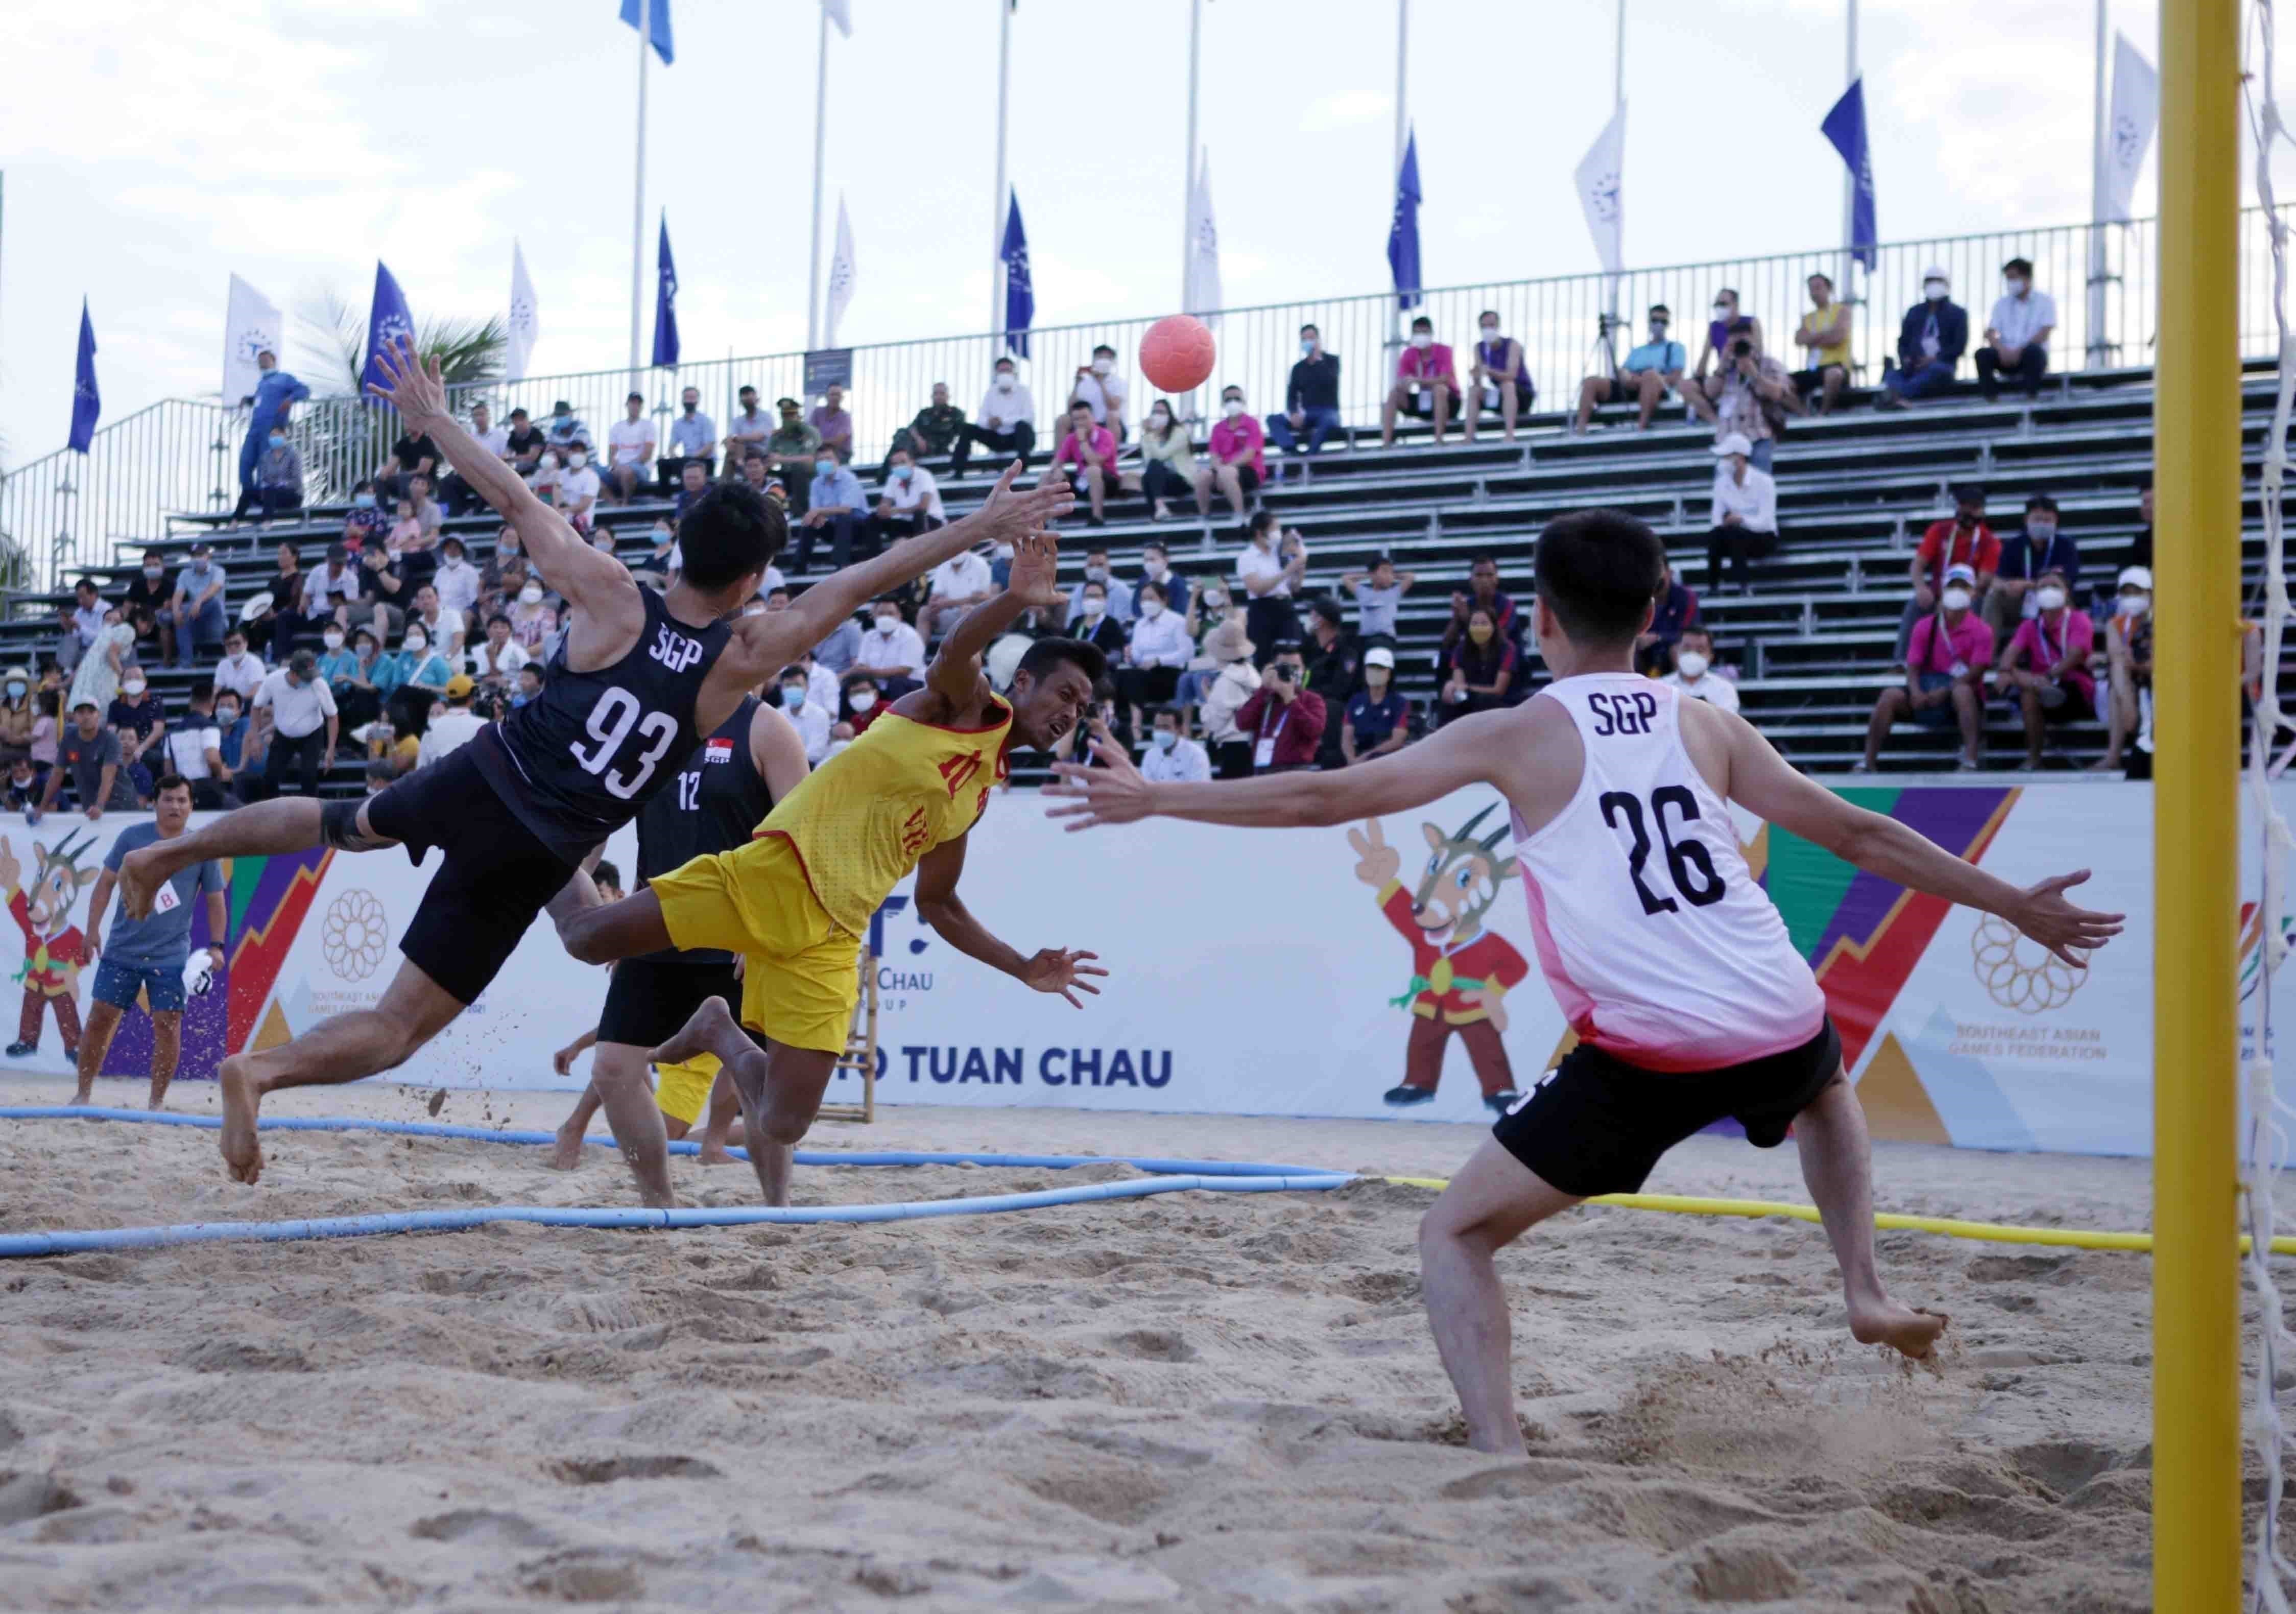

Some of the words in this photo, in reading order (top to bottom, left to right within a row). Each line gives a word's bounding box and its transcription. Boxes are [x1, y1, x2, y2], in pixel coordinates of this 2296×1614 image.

[649, 622, 703, 673] SGP
[1588, 692, 1657, 736] SGP
[569, 686, 678, 799] 93
[678, 771, 700, 811] 12
[1599, 785, 1726, 915] 26
[1949, 1042, 2003, 1055] GAMES
[2007, 1044, 2108, 1060] FEDERATION
[1956, 1024, 2048, 1040] SOUTHEAST
[2053, 1029, 2101, 1042] ASIAN
[902, 1047, 1023, 1084] TUAN
[1039, 1047, 1173, 1089] CHAU
